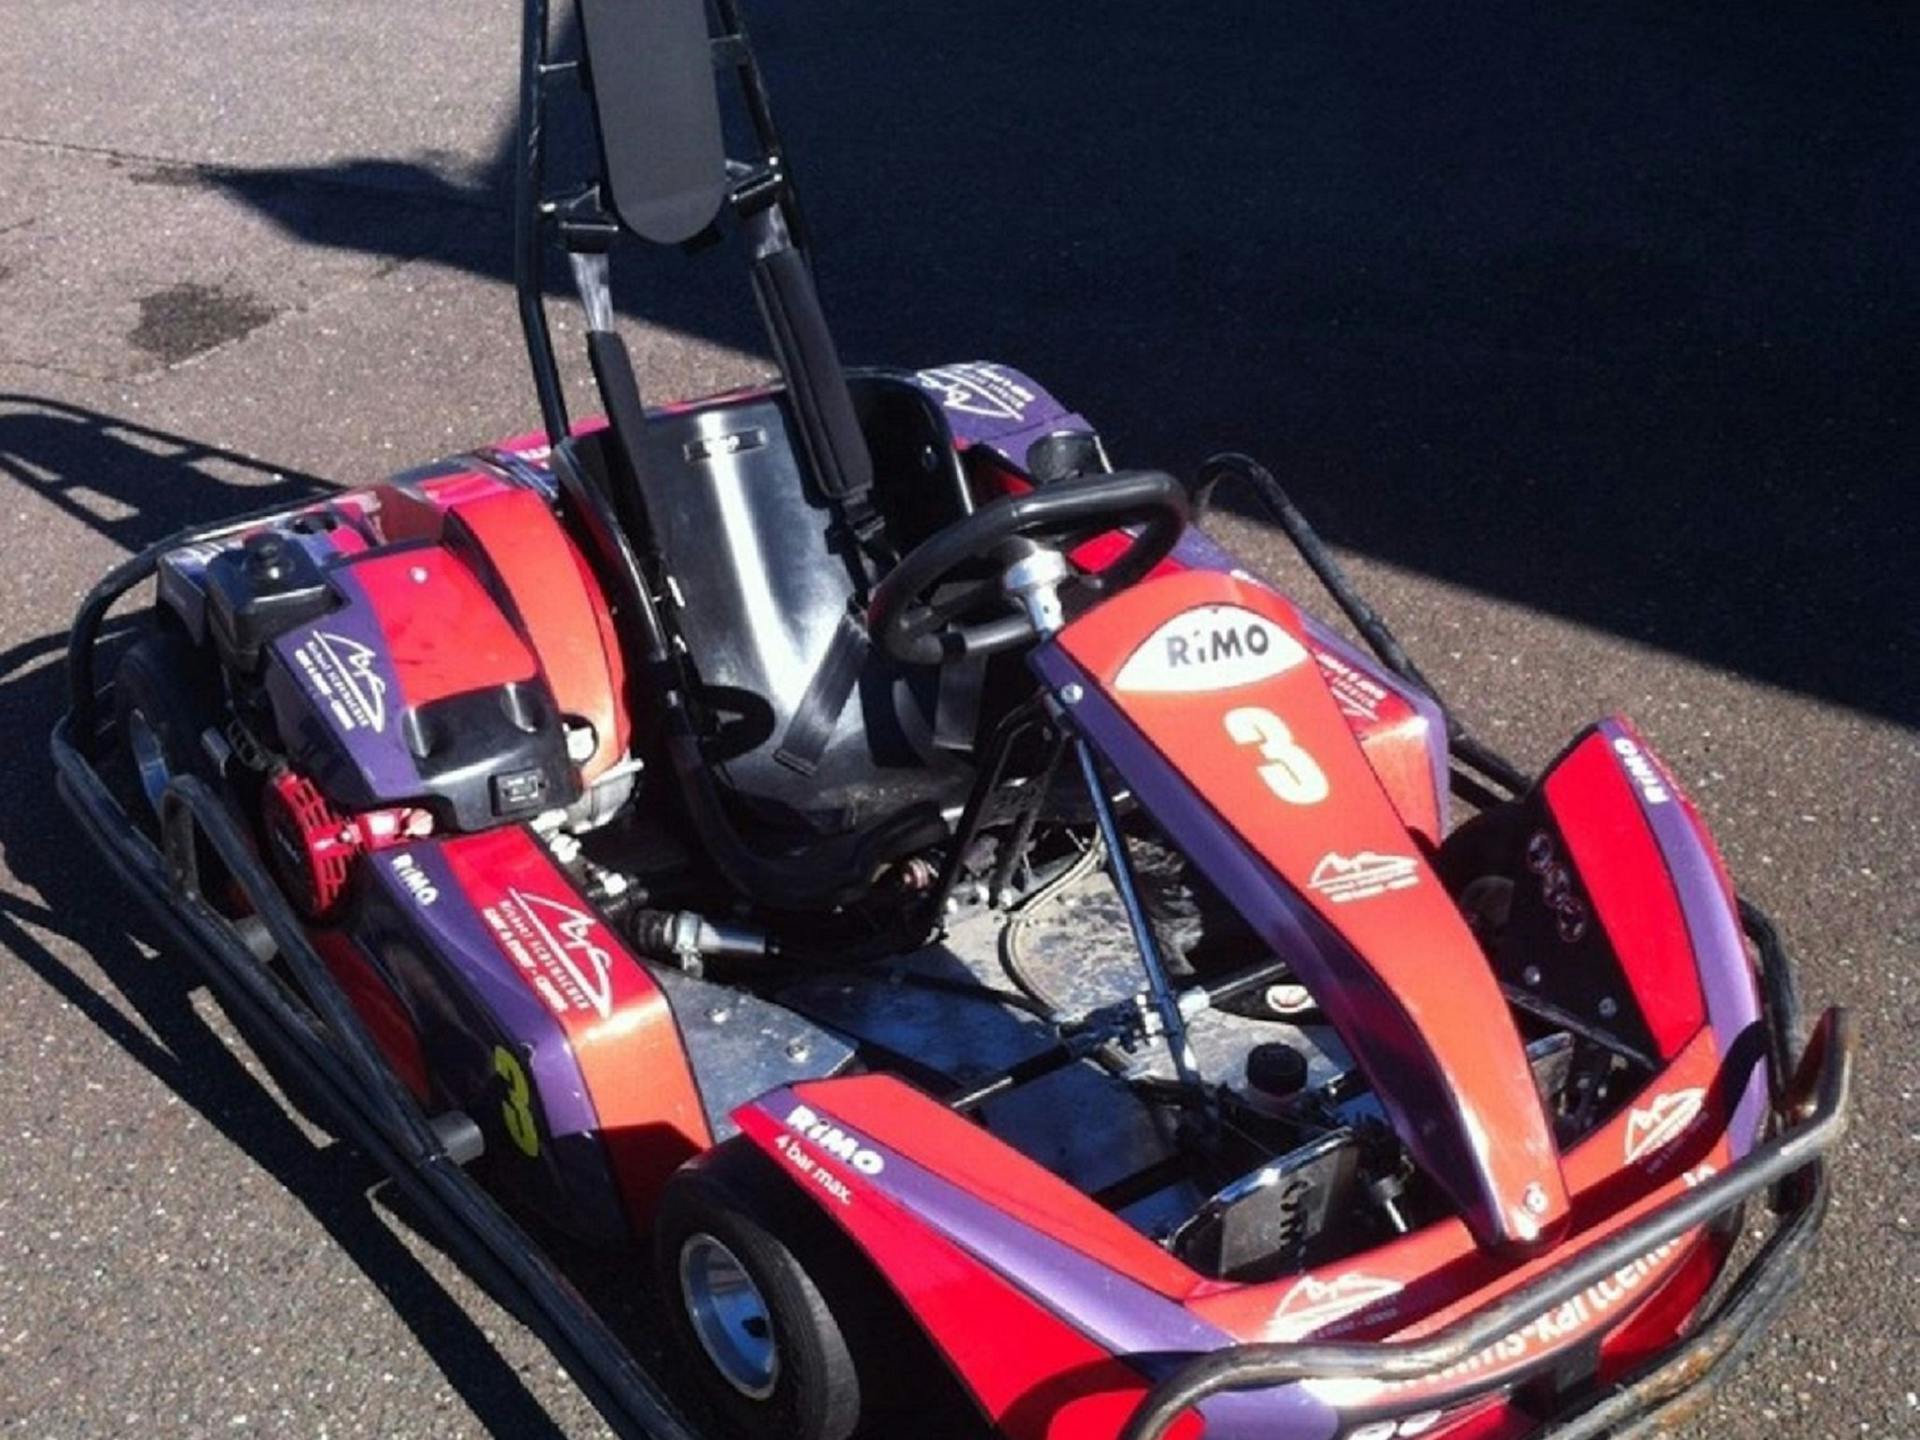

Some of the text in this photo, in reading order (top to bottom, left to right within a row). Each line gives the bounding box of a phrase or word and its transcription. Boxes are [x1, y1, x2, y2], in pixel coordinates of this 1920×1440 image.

[1223, 706, 1329, 805] 3
[494, 1045, 538, 1157] 3
[774, 1135, 790, 1149] 4
[786, 1140, 817, 1173] bar
